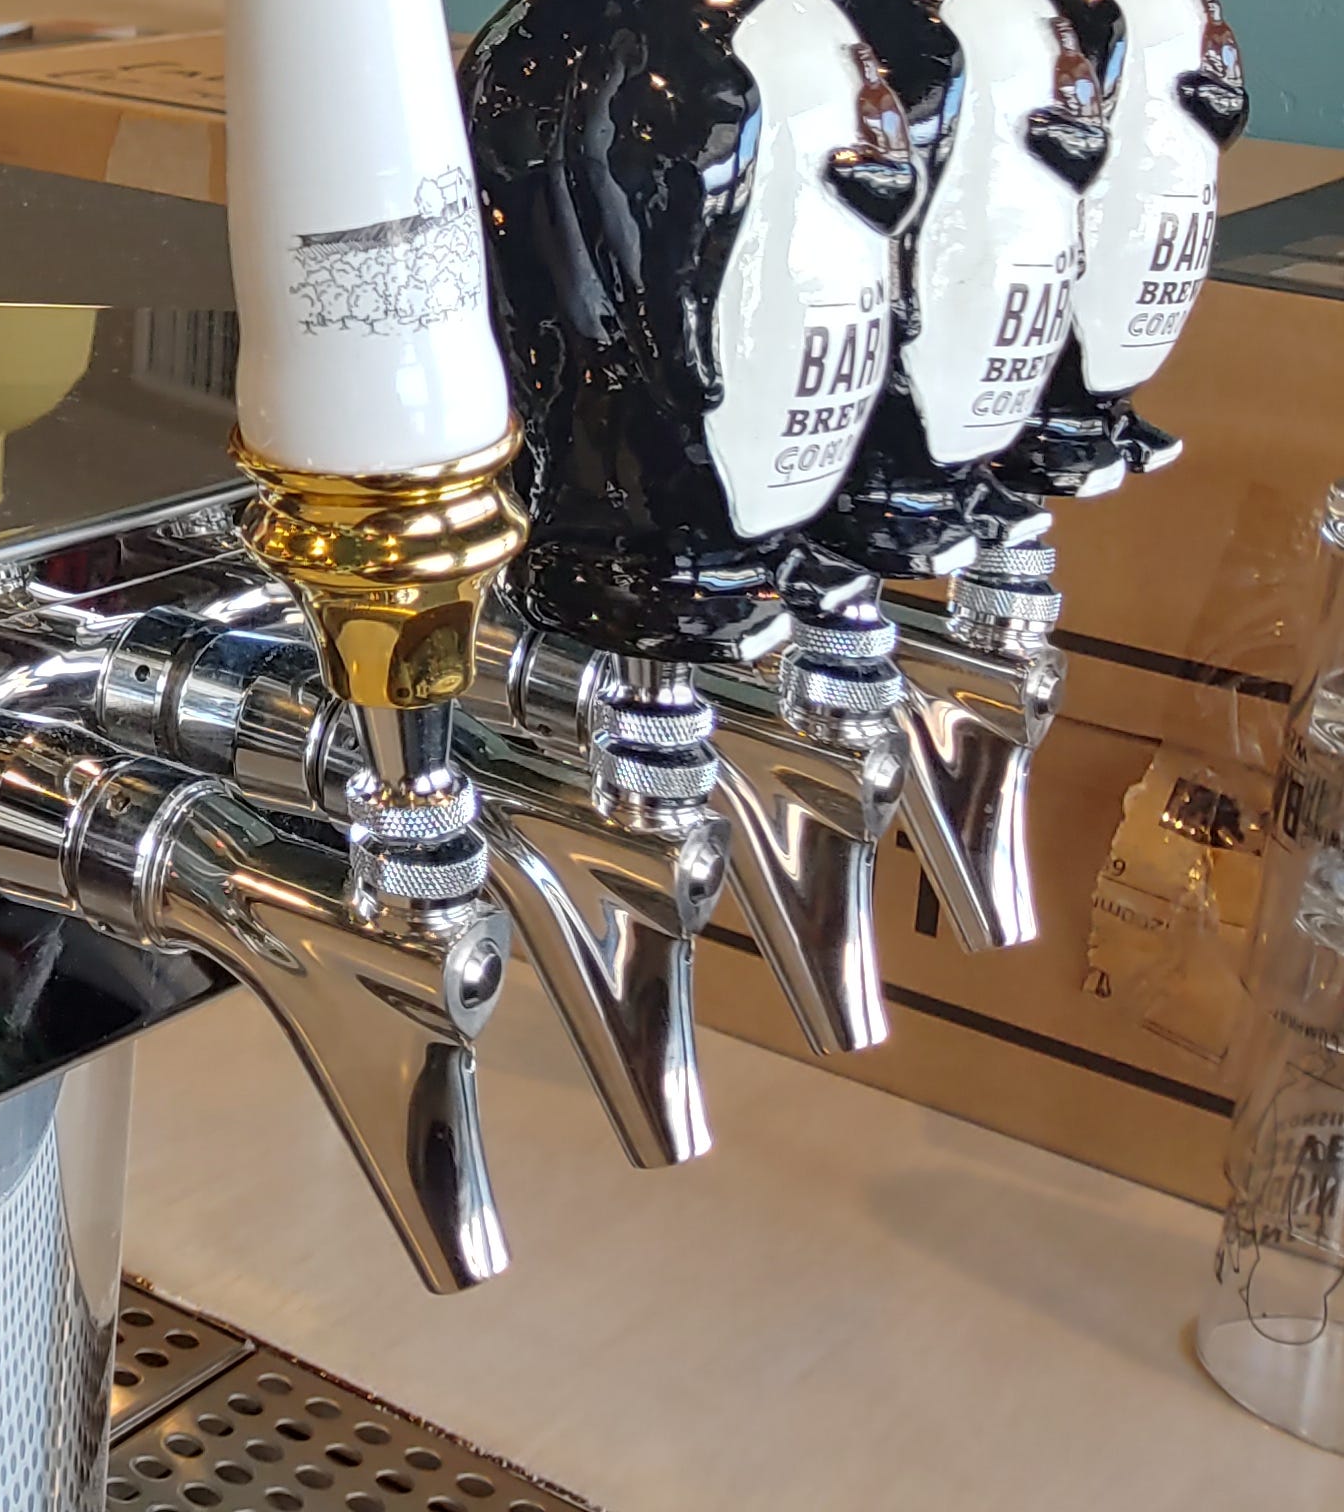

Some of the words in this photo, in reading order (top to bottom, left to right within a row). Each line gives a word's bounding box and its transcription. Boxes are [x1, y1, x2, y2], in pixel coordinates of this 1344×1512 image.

[1149, 211, 1215, 271] BAR
[993, 279, 1071, 347] BAR
[795, 317, 882, 397] BAR
